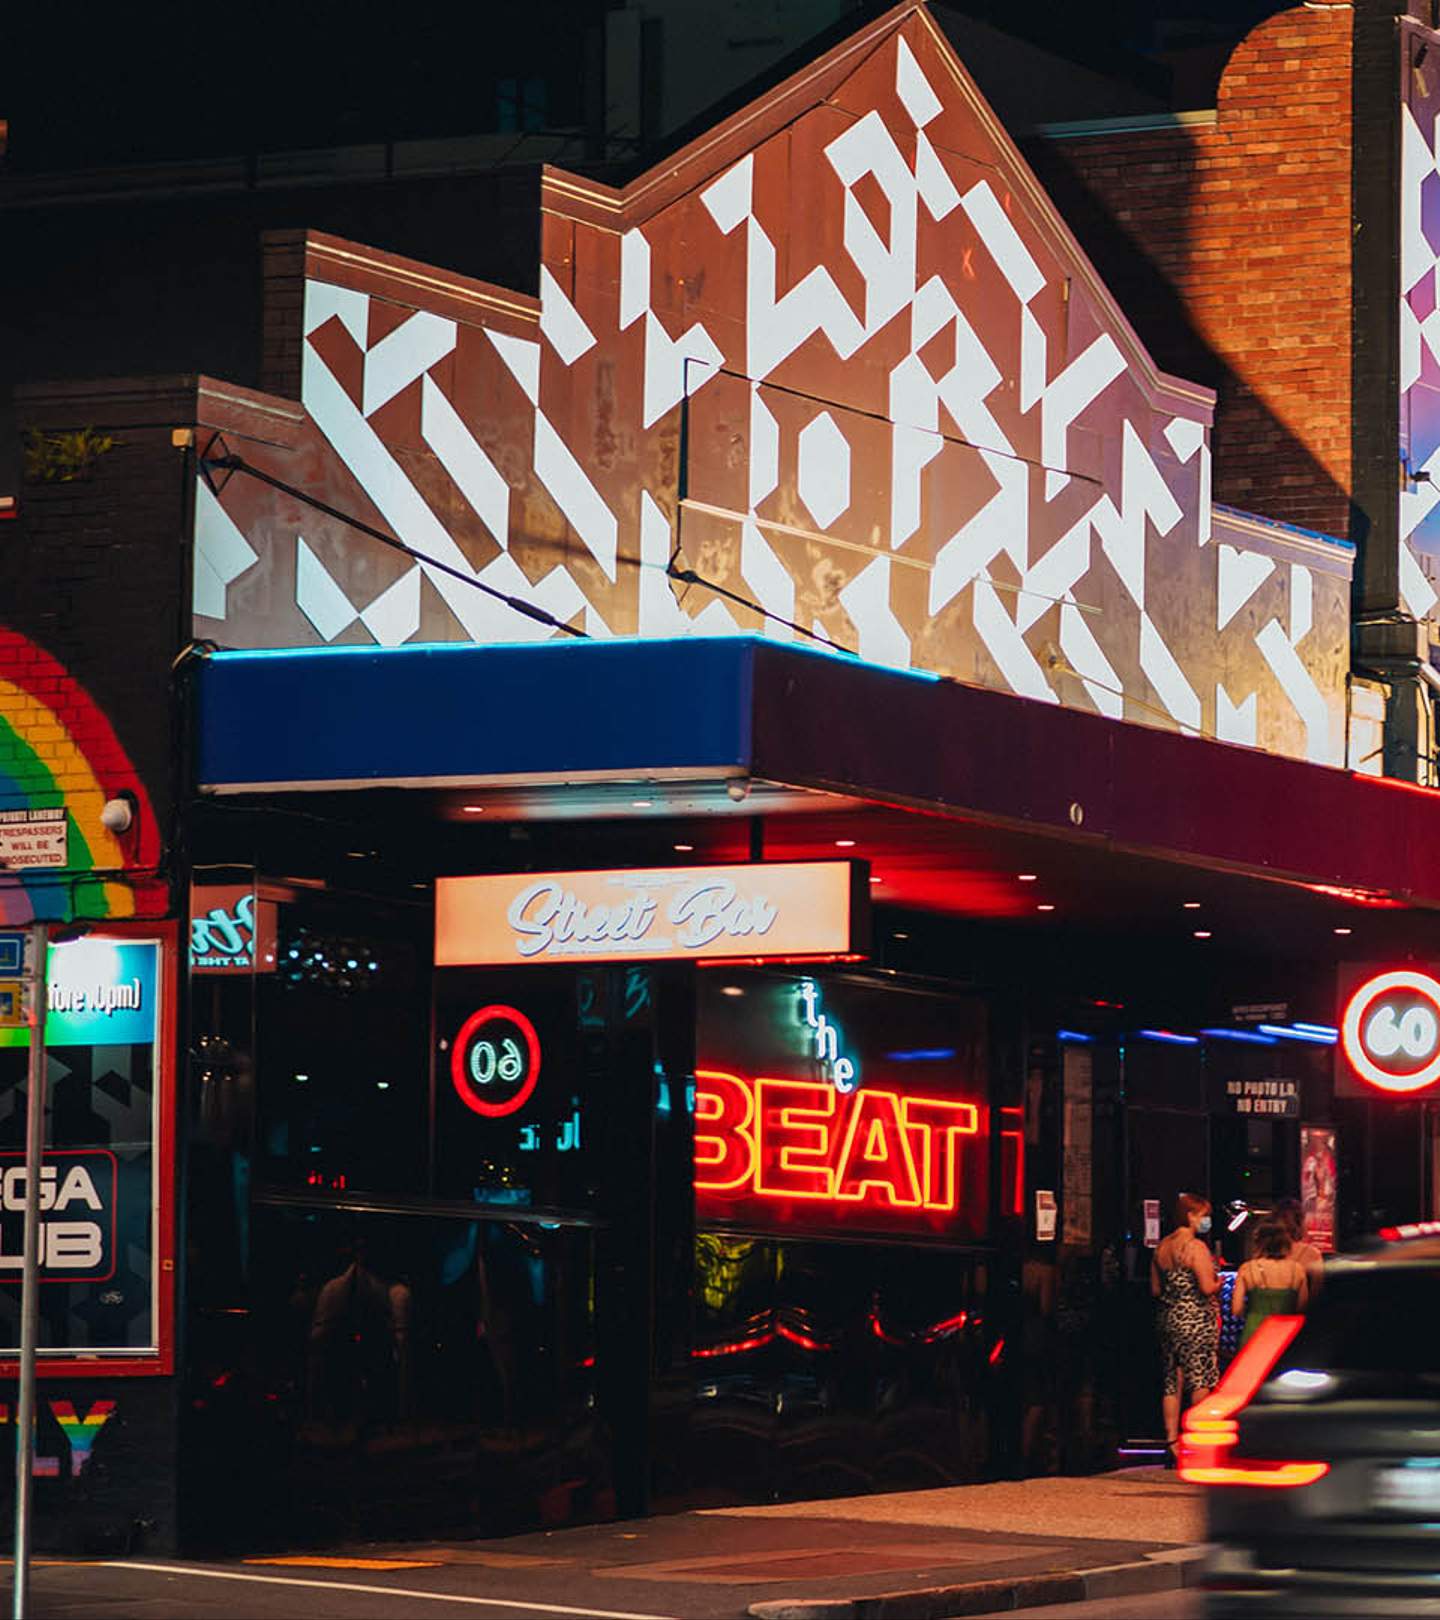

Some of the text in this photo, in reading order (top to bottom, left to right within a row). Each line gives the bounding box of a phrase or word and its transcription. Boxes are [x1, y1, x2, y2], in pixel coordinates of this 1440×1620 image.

[11, 840, 49, 850] WILL BE
[508, 879, 779, 957] Street Bar
[800, 978, 854, 1093] the
[1366, 1005, 1437, 1057] 60
[1227, 1081, 1242, 1094] NO
[1237, 1099, 1288, 1113] NO ENTRY
[695, 1069, 978, 1210] BEAT
[0, 1165, 103, 1211] GA
